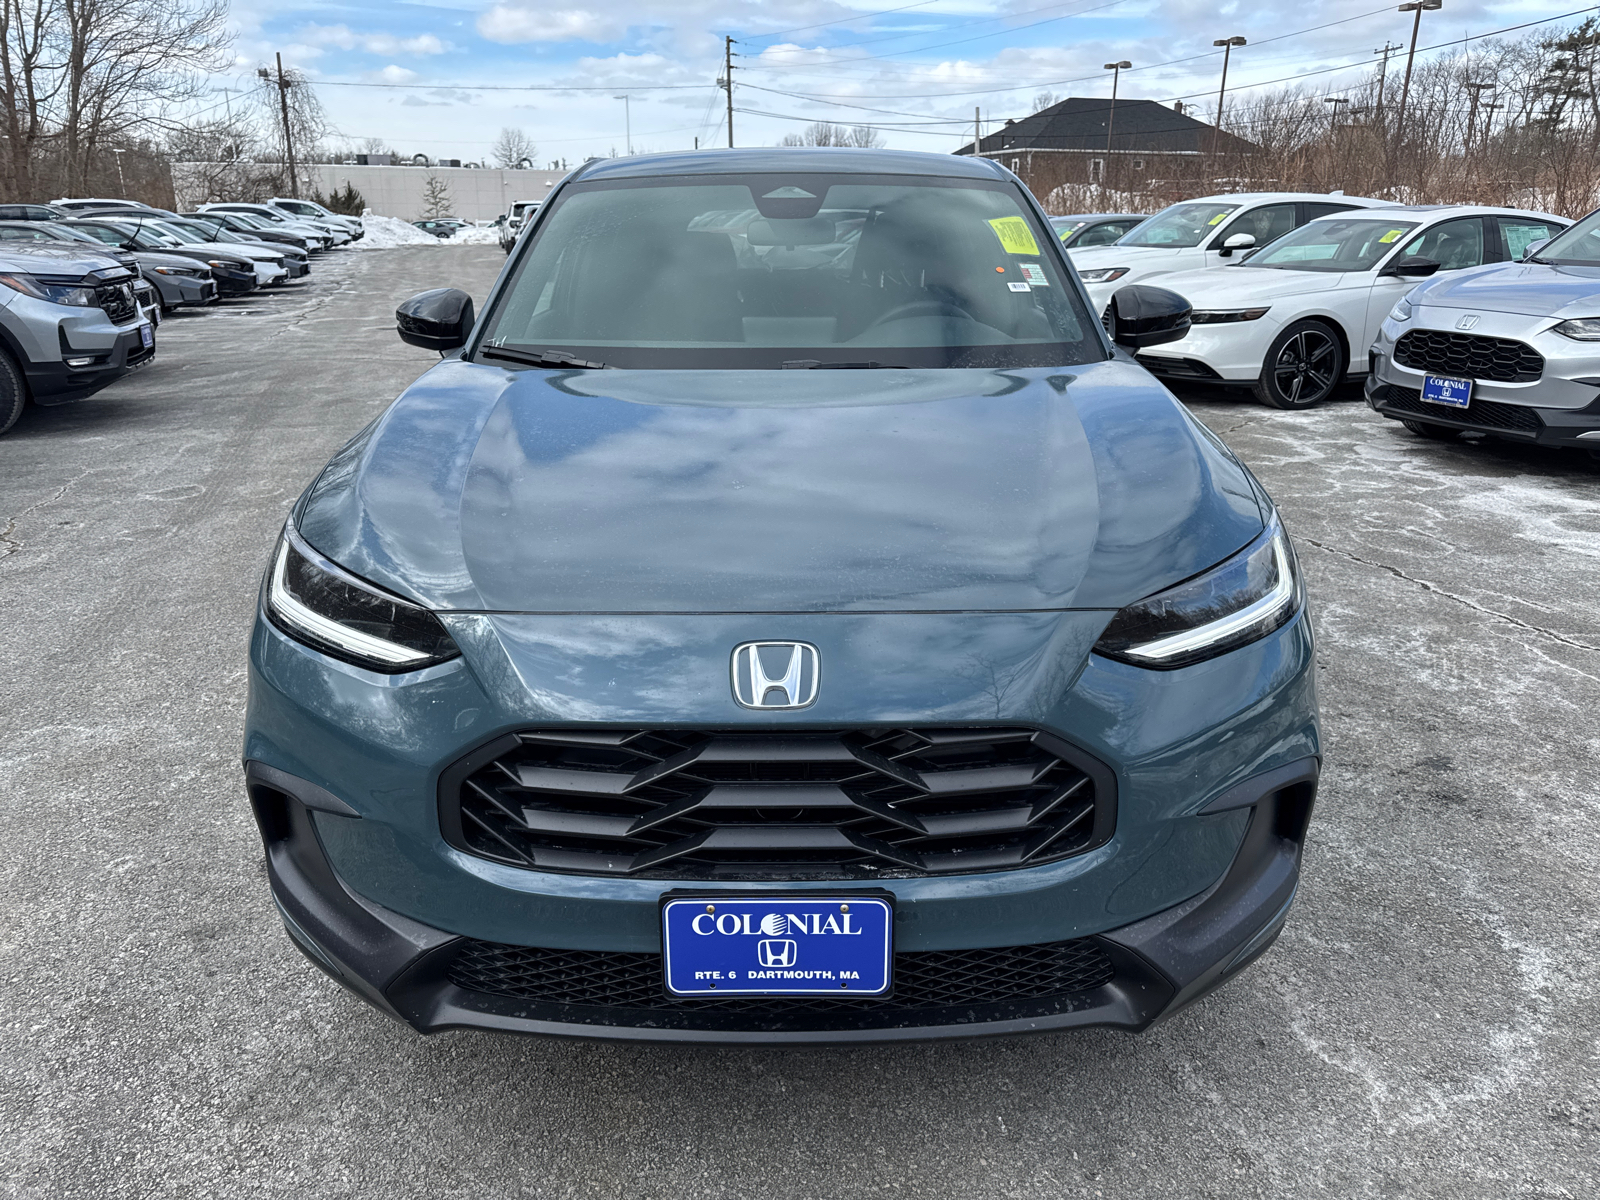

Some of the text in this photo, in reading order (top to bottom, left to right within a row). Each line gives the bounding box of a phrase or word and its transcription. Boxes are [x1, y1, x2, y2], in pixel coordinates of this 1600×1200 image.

[692, 913, 863, 936] COLONIAL
[695, 971, 860, 982] RTE. 6 DARTMOUTH, MA
